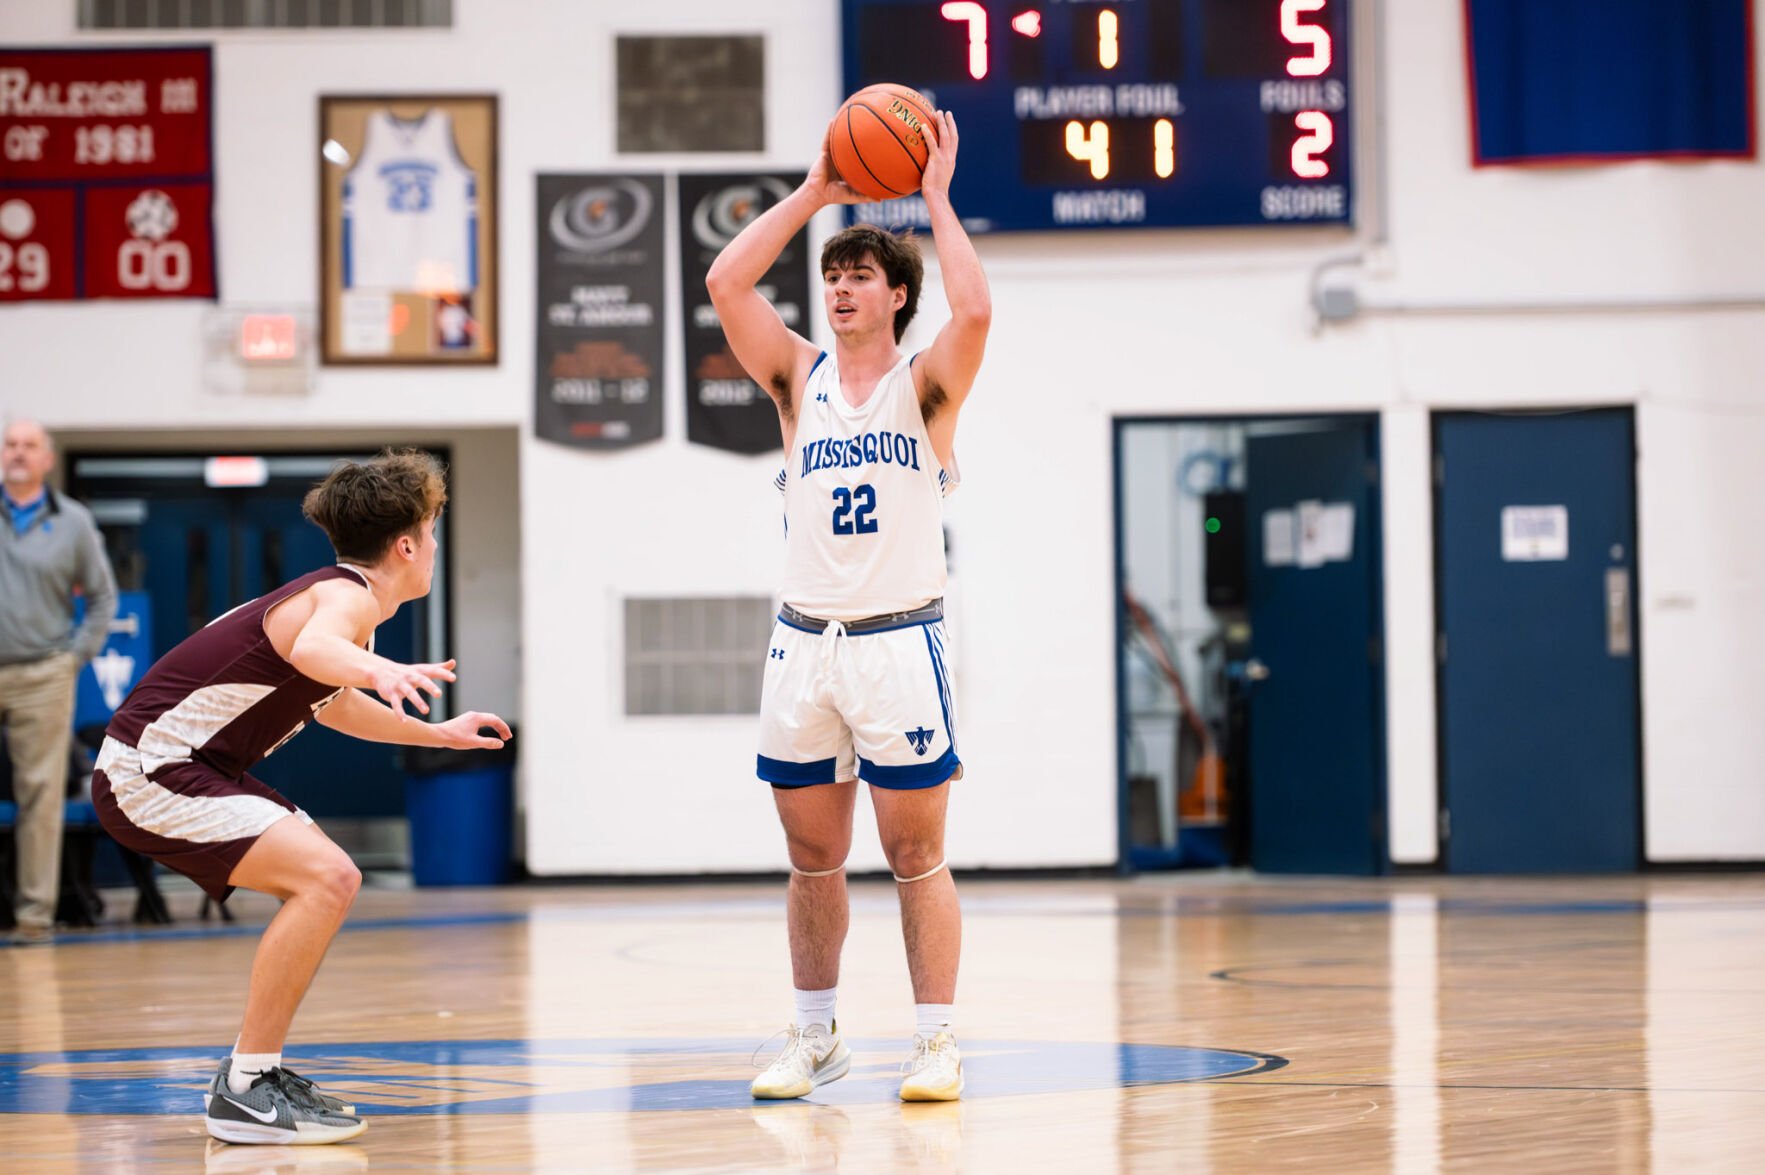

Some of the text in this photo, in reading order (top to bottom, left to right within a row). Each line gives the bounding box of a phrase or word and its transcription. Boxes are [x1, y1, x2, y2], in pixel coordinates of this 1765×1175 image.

[940, 1, 989, 80] 7
[1098, 9, 1119, 70] 1
[1280, 0, 1332, 76] 5
[1014, 83, 1184, 119] PLAYER FOUL
[1260, 79, 1346, 113] FOULS
[5, 124, 155, 165] OF 1981
[1291, 110, 1333, 178] 2
[1260, 185, 1346, 220] SCORE
[117, 238, 192, 291] 00
[801, 431, 921, 478] MISSISQUOI
[832, 484, 878, 535] 22
